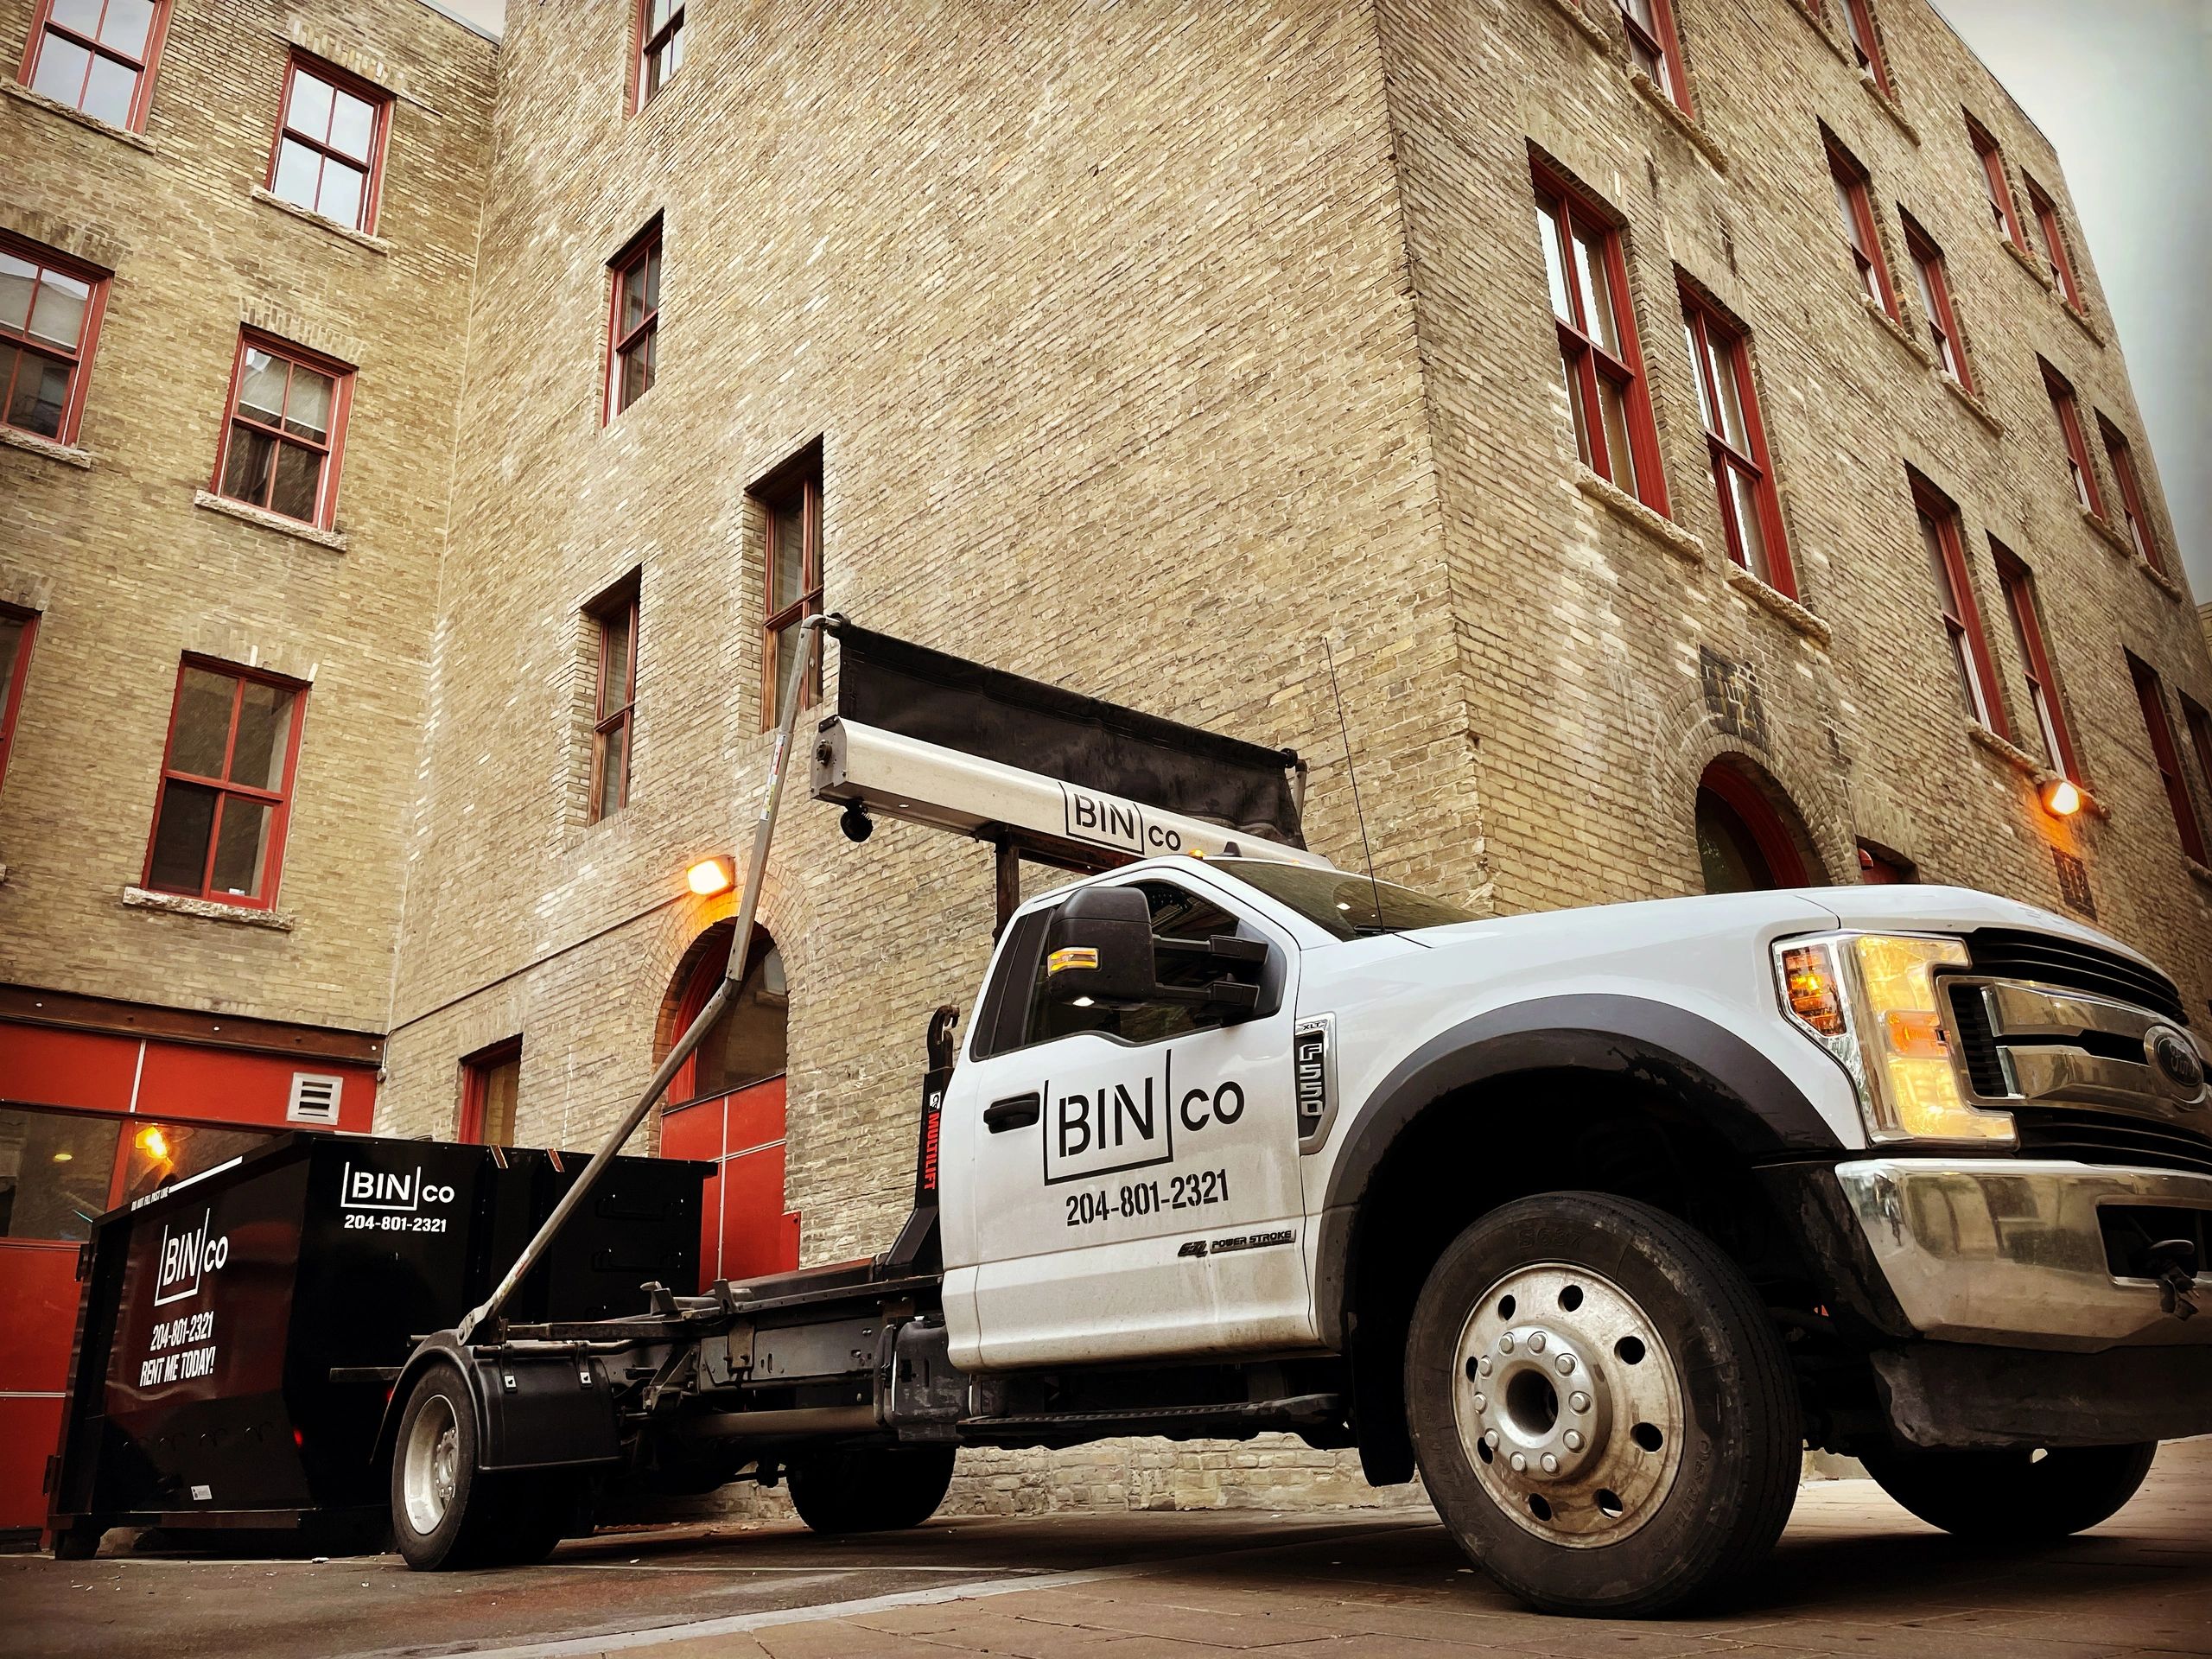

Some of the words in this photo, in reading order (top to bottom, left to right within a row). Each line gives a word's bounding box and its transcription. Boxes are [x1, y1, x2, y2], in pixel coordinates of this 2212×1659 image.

[1074, 793, 1134, 840] BIN
[1302, 1021, 1321, 1031] XLT
[1299, 1042, 1323, 1116] F550
[1058, 1076, 1154, 1158] BIN
[925, 1111, 940, 1190] MULTILIFT
[352, 1171, 410, 1200] BIN
[1065, 1168, 1229, 1226] 204-801-2321
[344, 1214, 447, 1233] 204-801-2321
[1211, 1236, 1247, 1249] POWER
[1249, 1230, 1292, 1244] STROKE
[162, 1228, 201, 1286] BIN
[149, 1310, 213, 1351] 204-801-2321
[139, 1356, 165, 1387] RENT
[164, 1353, 180, 1382] ME
[181, 1345, 216, 1379] TODAY!
